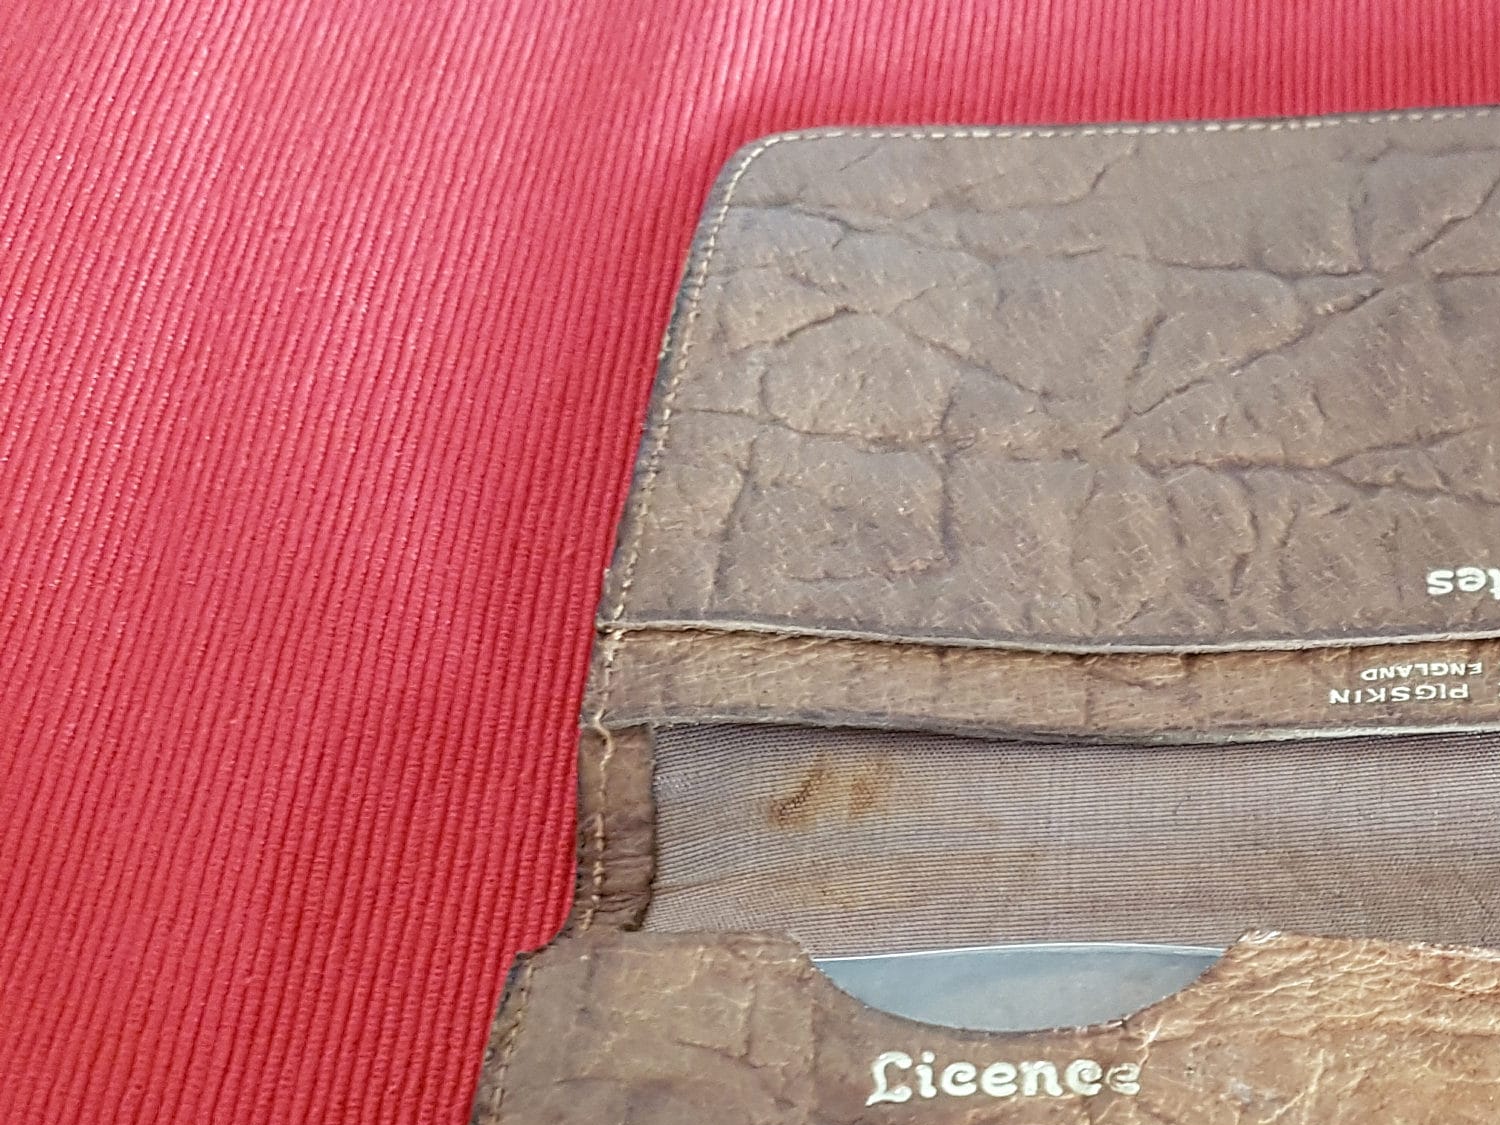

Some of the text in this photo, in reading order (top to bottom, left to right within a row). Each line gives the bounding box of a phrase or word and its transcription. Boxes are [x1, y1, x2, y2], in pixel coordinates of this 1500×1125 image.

[1361, 662, 1483, 681] ENGLAND
[1329, 683, 1469, 705] PIGSKIN
[865, 1051, 1141, 1106] Licence
